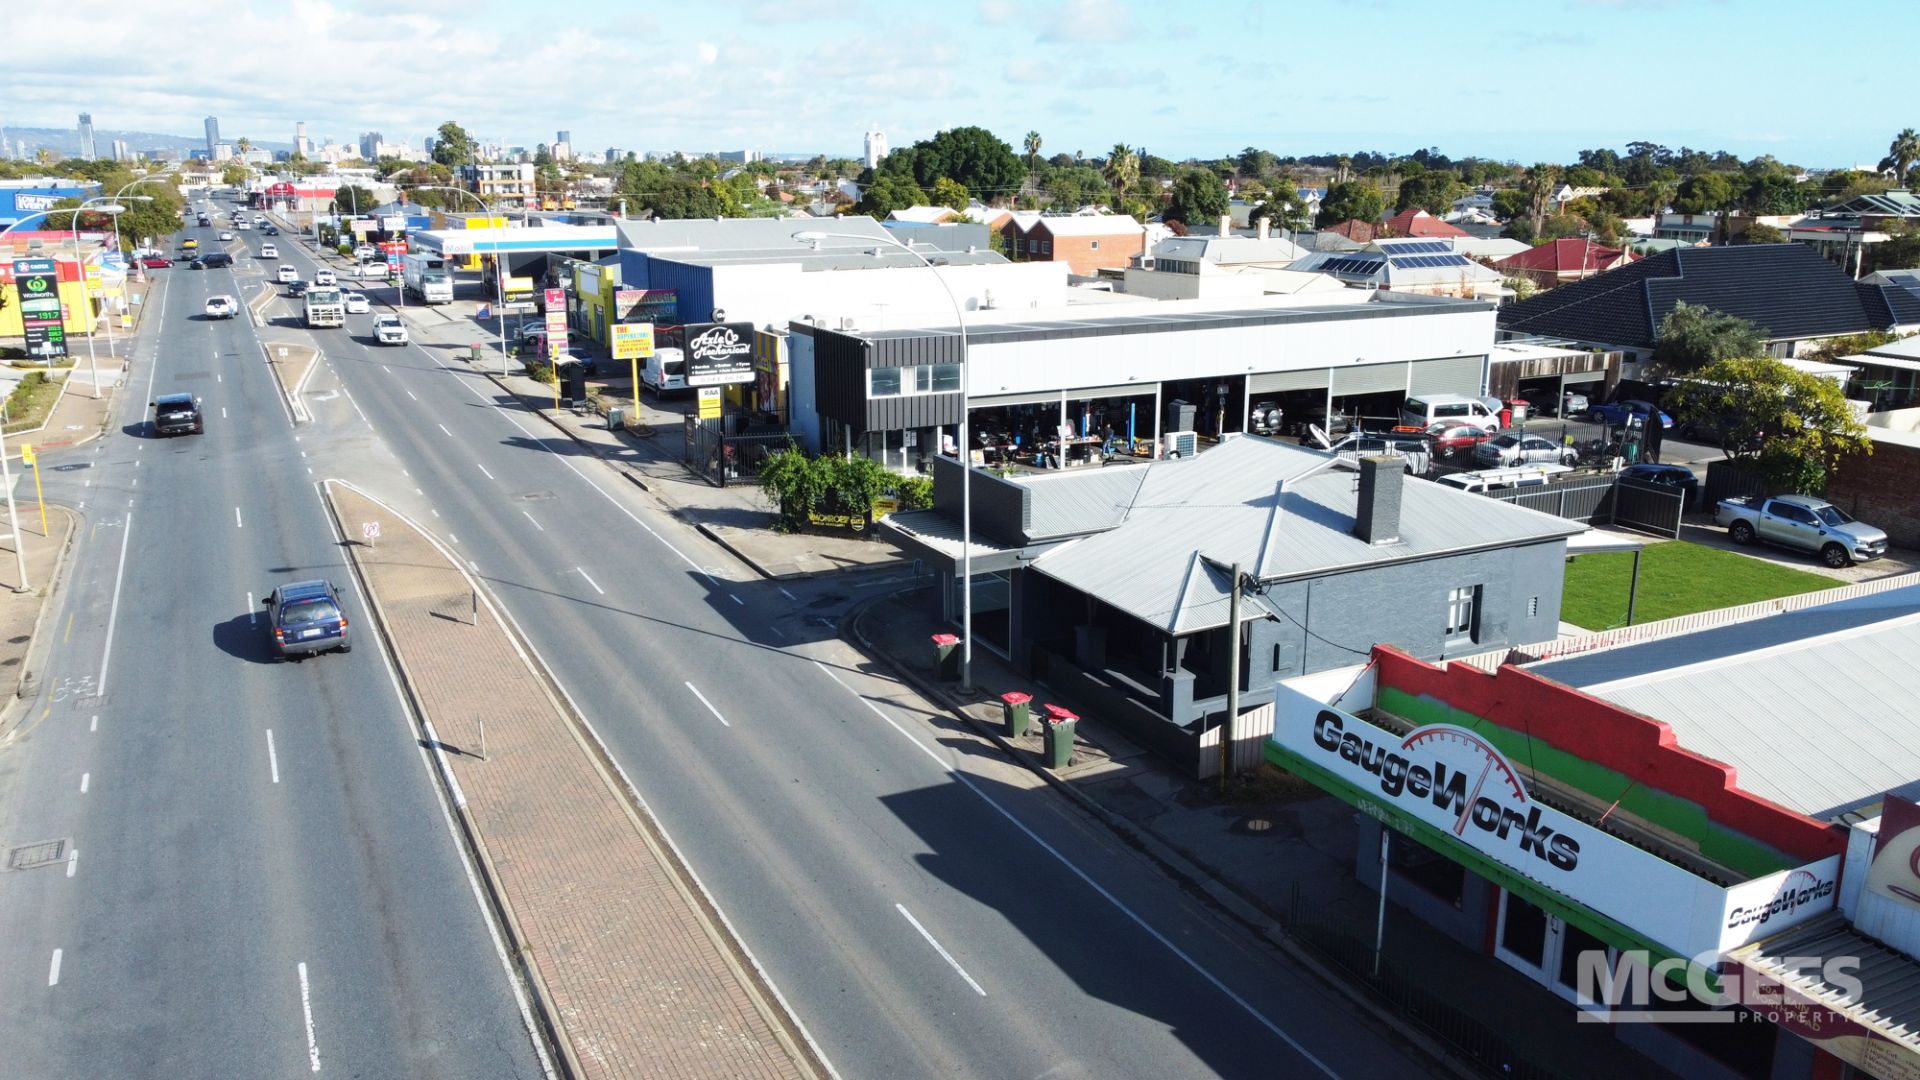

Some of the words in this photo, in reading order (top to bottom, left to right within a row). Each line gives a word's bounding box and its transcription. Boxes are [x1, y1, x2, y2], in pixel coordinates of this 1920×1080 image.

[690, 331, 725, 350] Axle
[693, 344, 751, 359] Mechanical
[1313, 709, 1580, 871] GaugeWorks
[1728, 879, 1834, 928] GaugeWorks
[1753, 990, 1787, 1012] NORTH
[1790, 1010, 1820, 1031] ROAD
[1784, 996, 1809, 1014] MAIN
